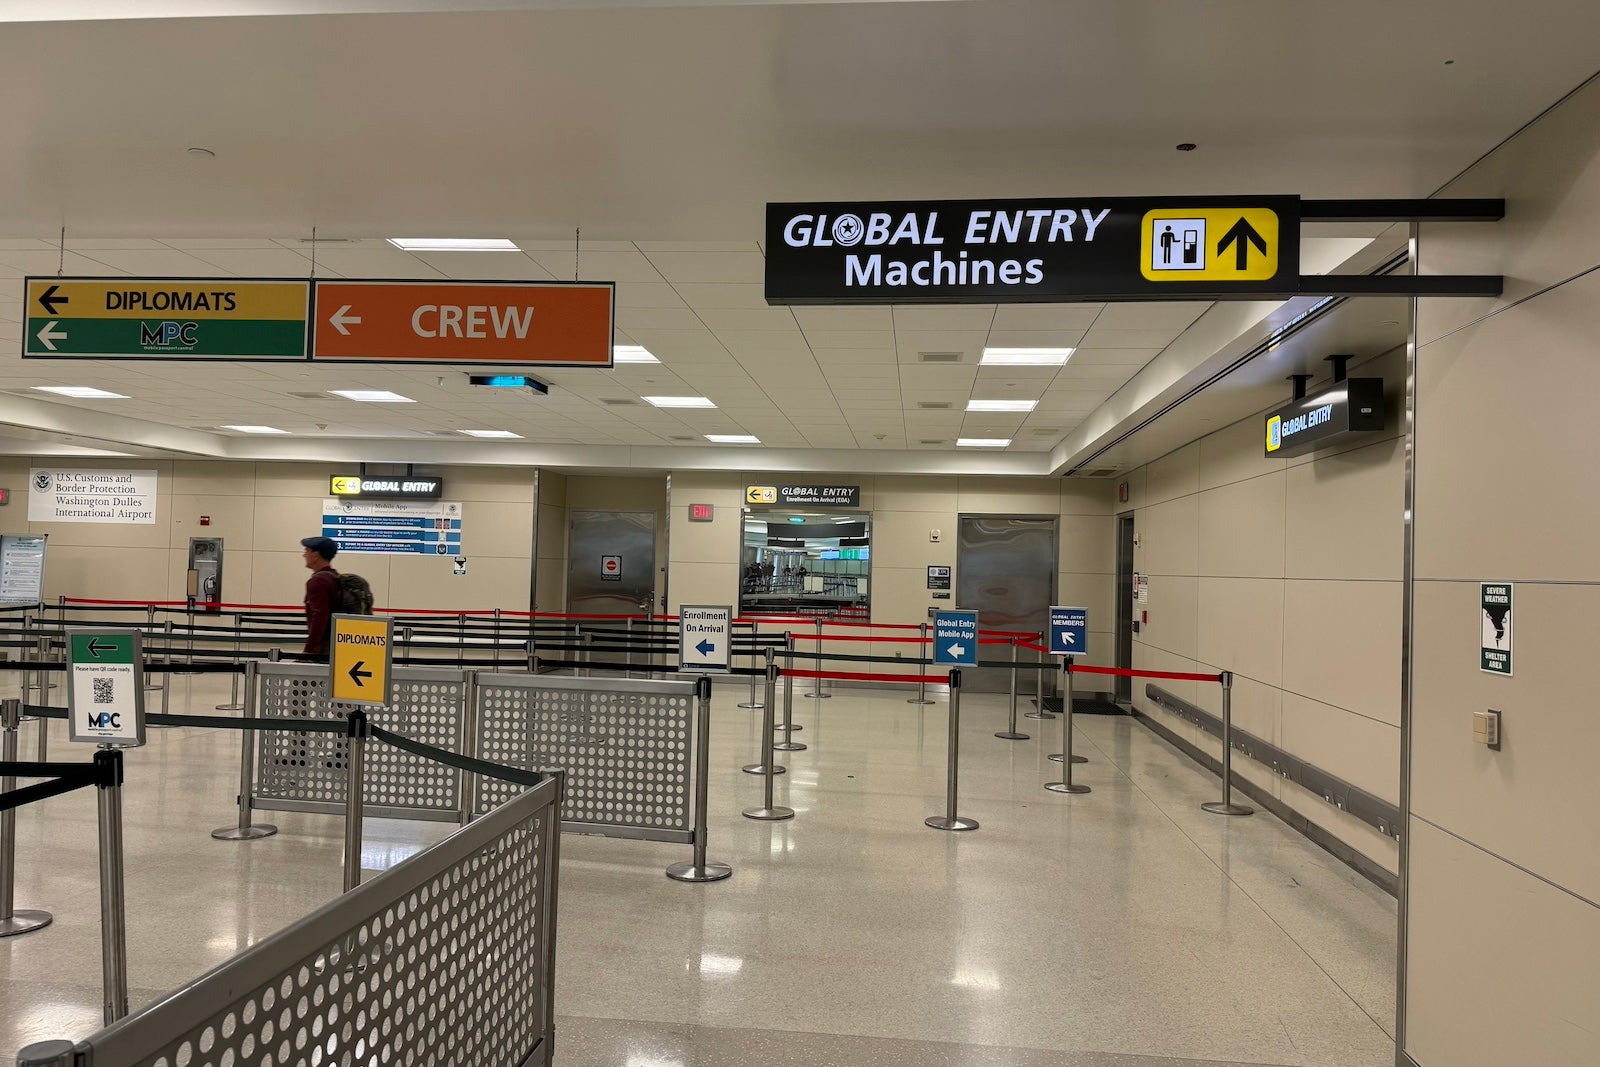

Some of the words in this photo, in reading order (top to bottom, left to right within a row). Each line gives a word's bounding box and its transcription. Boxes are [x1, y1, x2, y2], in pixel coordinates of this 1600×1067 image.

[783, 212, 946, 248] GLOBAL
[964, 208, 1112, 244] ENTRY
[845, 250, 1044, 286] Machines
[105, 290, 236, 311] DIPLOMATS
[411, 304, 535, 339] CREW
[140, 321, 199, 346] MPC
[1282, 414, 1307, 437] GLOBAL
[1308, 404, 1333, 427] ENTRY
[56, 473, 73, 482] U.S.
[74, 473, 113, 483] Customs
[115, 474, 132, 483] and
[56, 483, 86, 493] Border
[89, 484, 136, 494] Protection
[361, 481, 400, 492] GLOBAL
[402, 482, 436, 492] ENTRY
[781, 487, 819, 496] GLOBAL
[823, 488, 855, 497] ENTRY
[56, 496, 110, 508] Washington
[113, 497, 142, 507] Dulles
[55, 508, 115, 518] International
[118, 509, 152, 520] Airport
[1486, 587, 1506, 595] SEVERE
[1484, 595, 1508, 604] WEATHER
[683, 610, 727, 620] Enrollment
[686, 623, 697, 632] On
[698, 624, 724, 633] Arrival
[937, 619, 958, 627] Global
[959, 620, 976, 629] Entry
[337, 633, 386, 646] DIPLOMATS
[938, 629, 961, 638] Mobile
[961, 631, 975, 640] App
[1485, 652, 1506, 661] SHELTER
[1488, 660, 1503, 670] AREA
[88, 712, 121, 728] MPC
